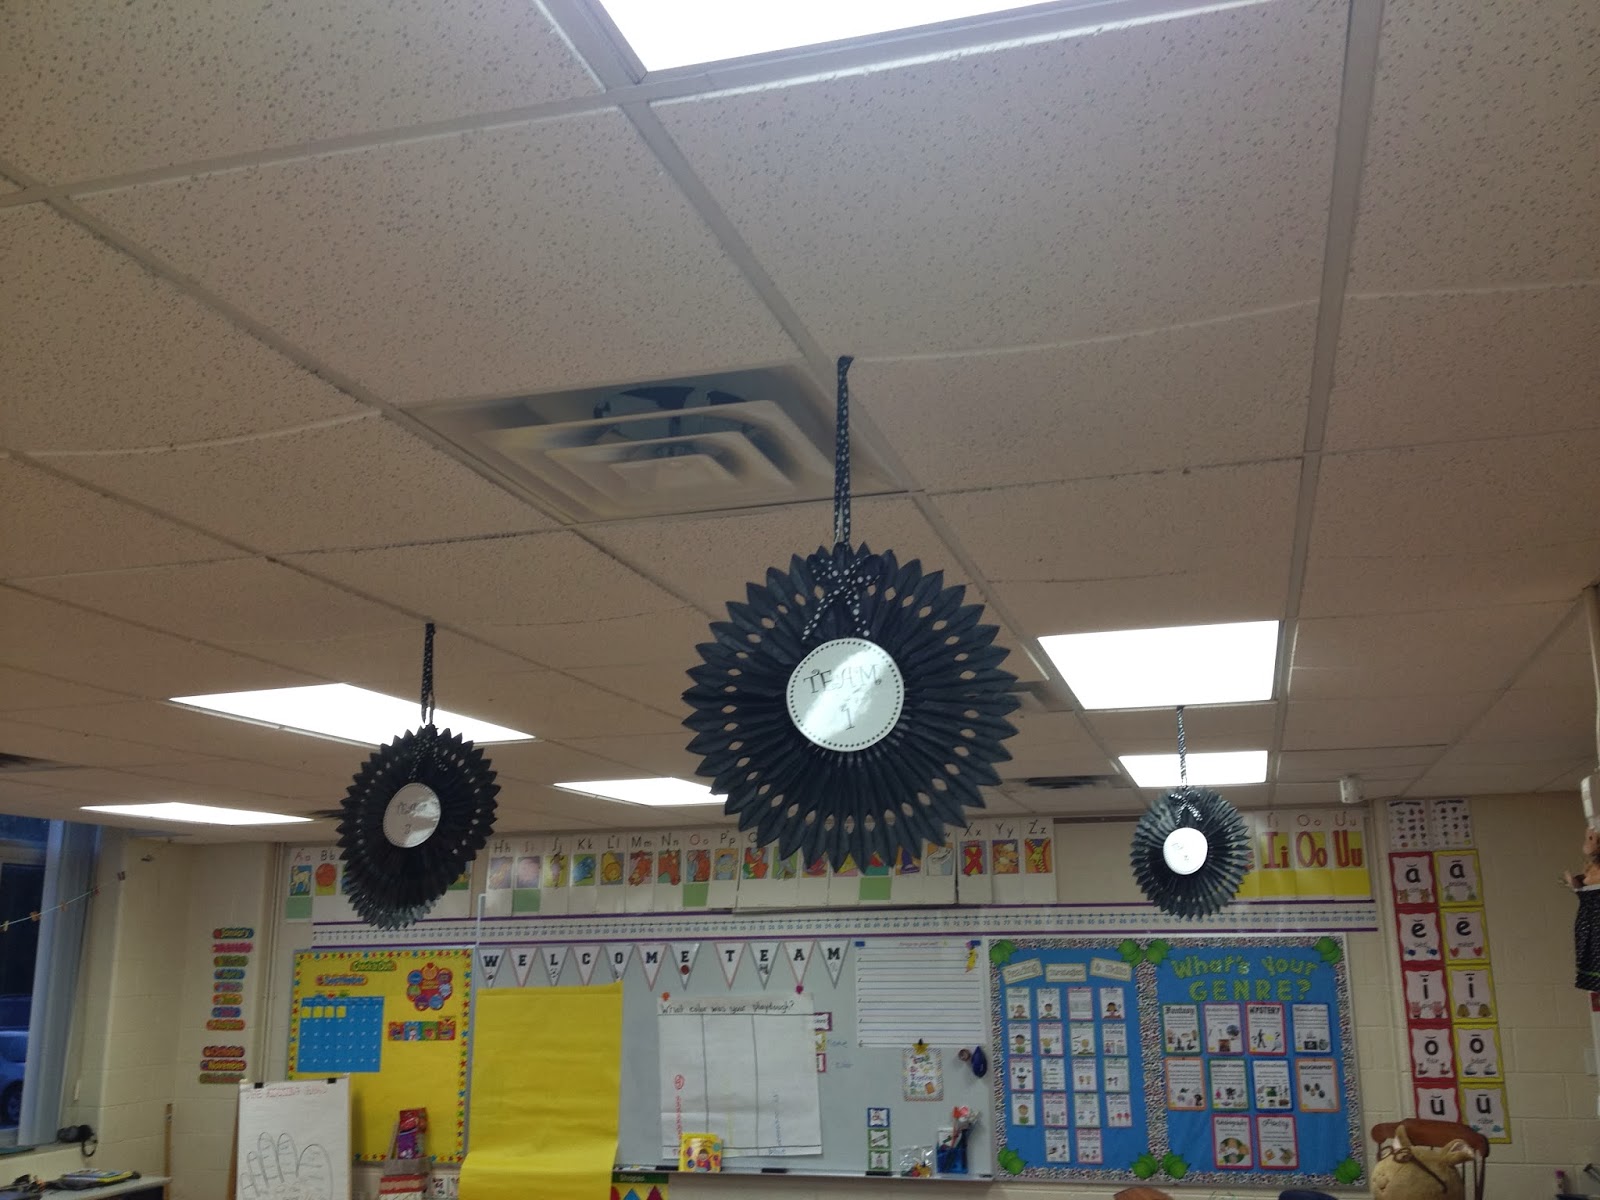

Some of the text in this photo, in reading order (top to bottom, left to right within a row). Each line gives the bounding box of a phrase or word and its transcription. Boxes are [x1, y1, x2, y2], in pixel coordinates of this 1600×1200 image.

[803, 663, 882, 694] TEAM
[483, 948, 841, 967] WELCOME TEAM
[1170, 955, 1250, 979] What's
[1189, 979, 1312, 1000] GENRE?
